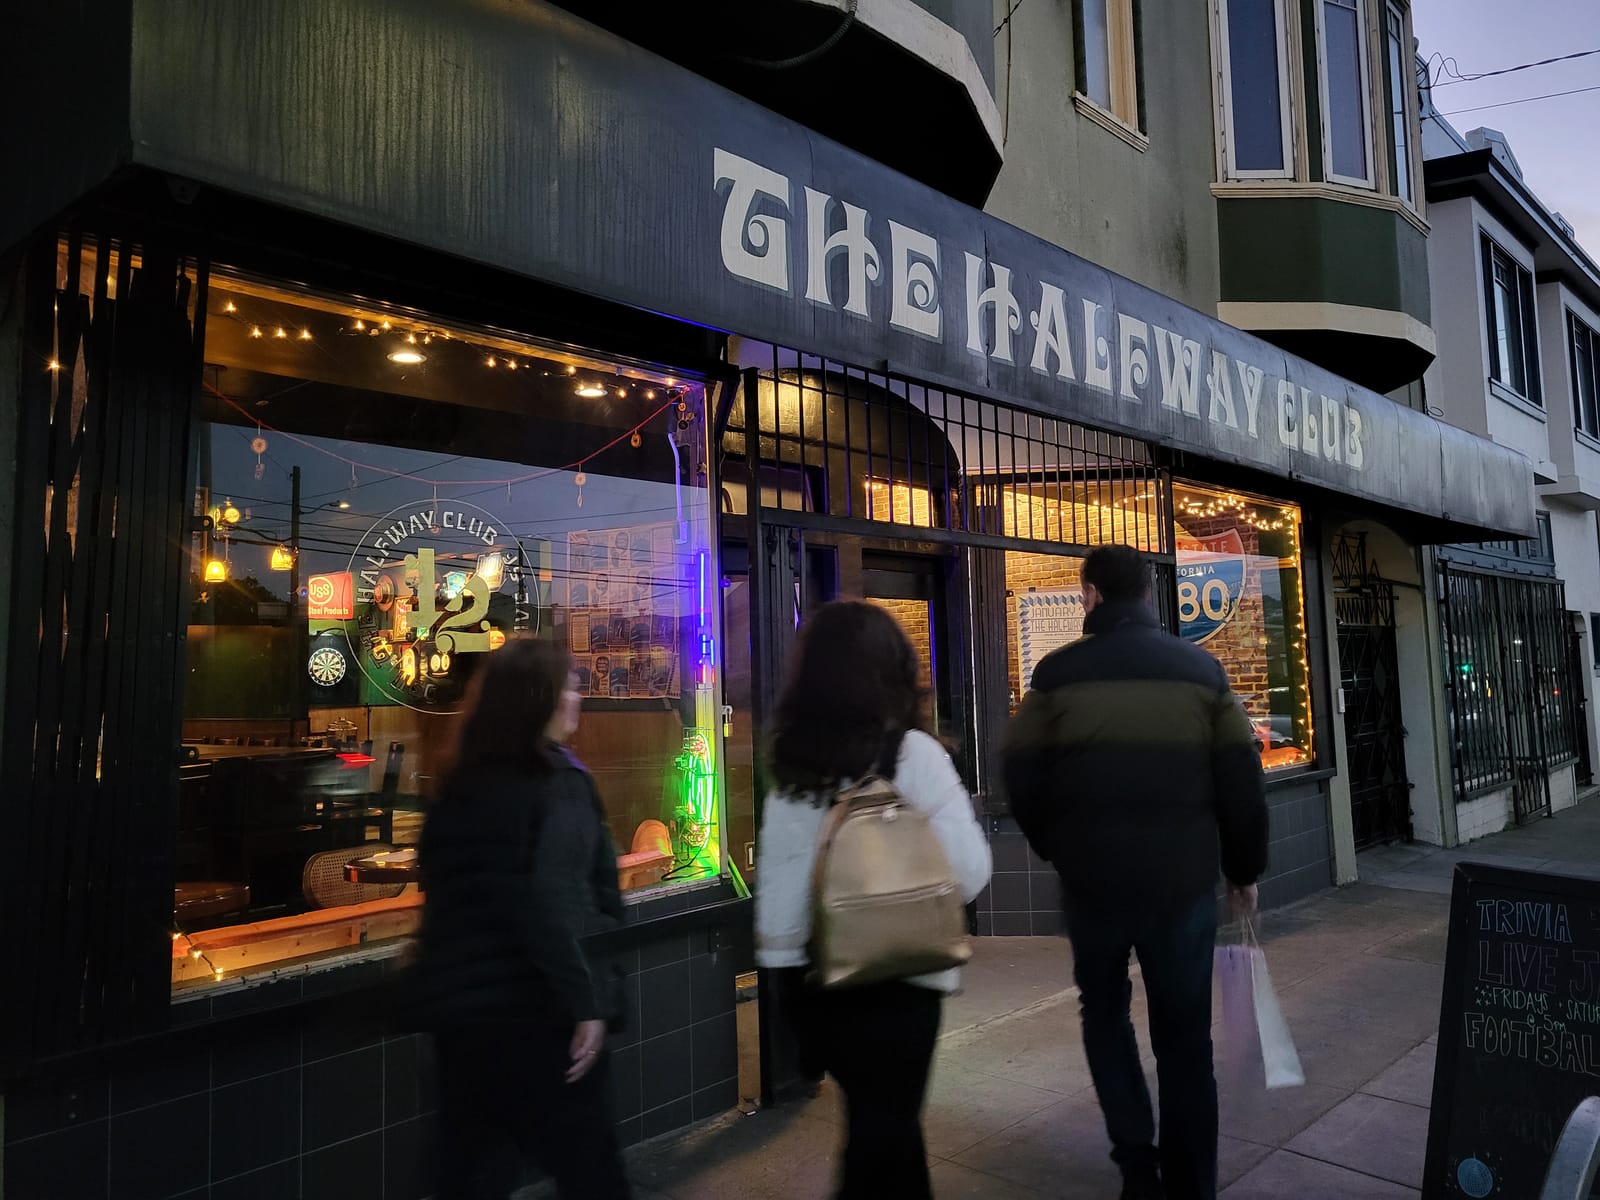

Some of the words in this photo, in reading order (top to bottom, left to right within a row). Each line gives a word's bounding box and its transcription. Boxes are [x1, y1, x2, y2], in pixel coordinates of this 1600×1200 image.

[713, 147, 943, 339] THE
[964, 250, 1264, 440] HALFWAY
[1277, 380, 1364, 471] CLUB
[357, 510, 434, 603] HALFWAY
[443, 511, 498, 546] CLUB
[310, 583, 330, 598] USS
[323, 606, 349, 615] Products
[1031, 607, 1076, 618] JANUARY
[1030, 619, 1046, 632] THE
[1048, 618, 1083, 632] HALFWAY
[1475, 899, 1573, 944] TRIVIA
[1477, 939, 1559, 994] LIVE
[1492, 987, 1550, 1015] FRIDAYS
